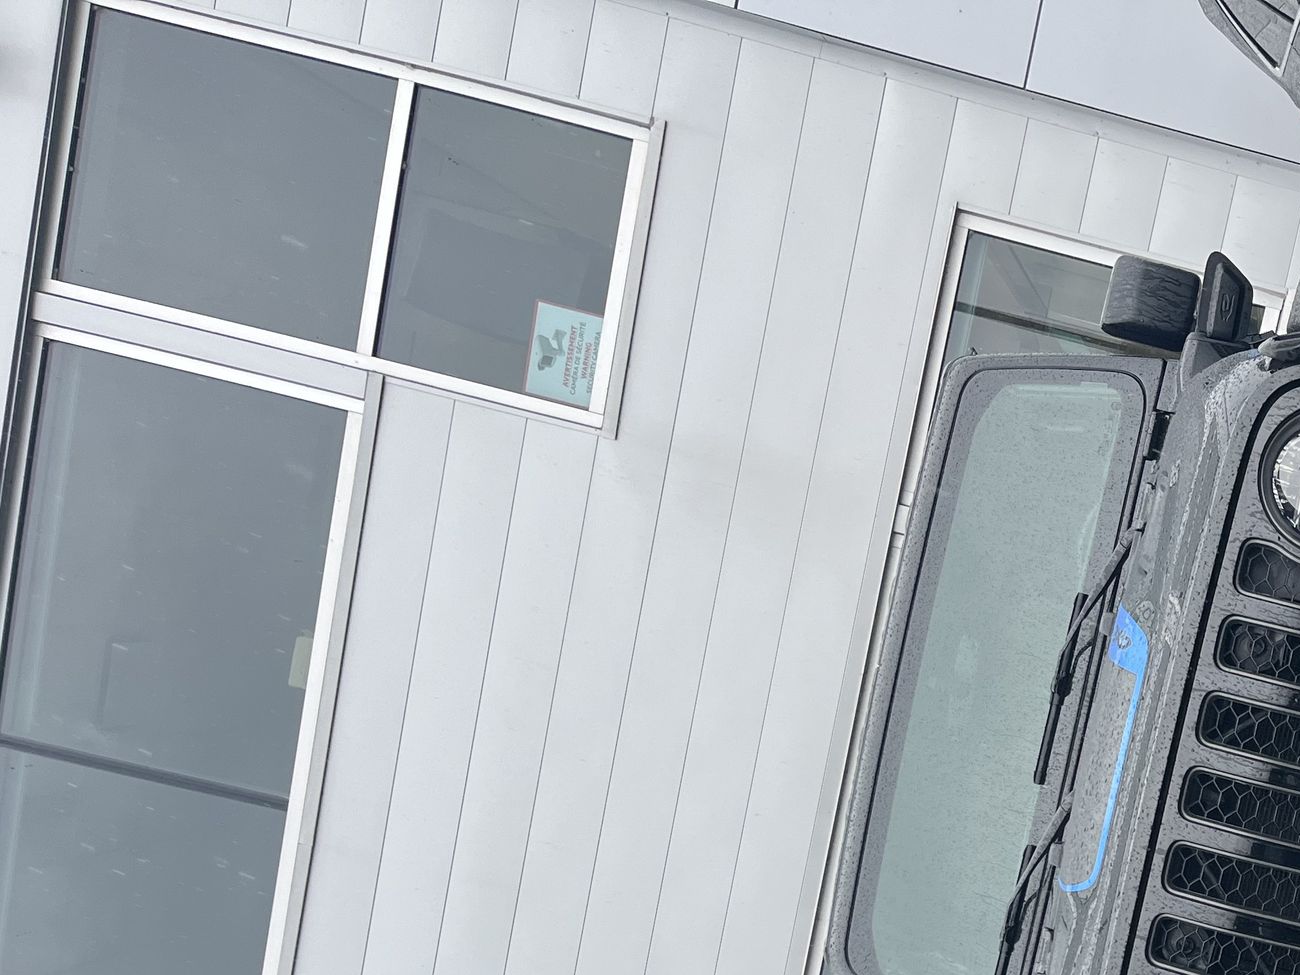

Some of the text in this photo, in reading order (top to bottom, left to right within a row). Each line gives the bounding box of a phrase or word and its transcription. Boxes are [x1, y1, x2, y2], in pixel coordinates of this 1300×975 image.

[563, 325, 577, 388] AVERTISSEMENT
[570, 321, 586, 396] CAMÉRA DE SÉCURITÉ
[581, 342, 592, 379] WARNING
[591, 331, 601, 361] CAMERA
